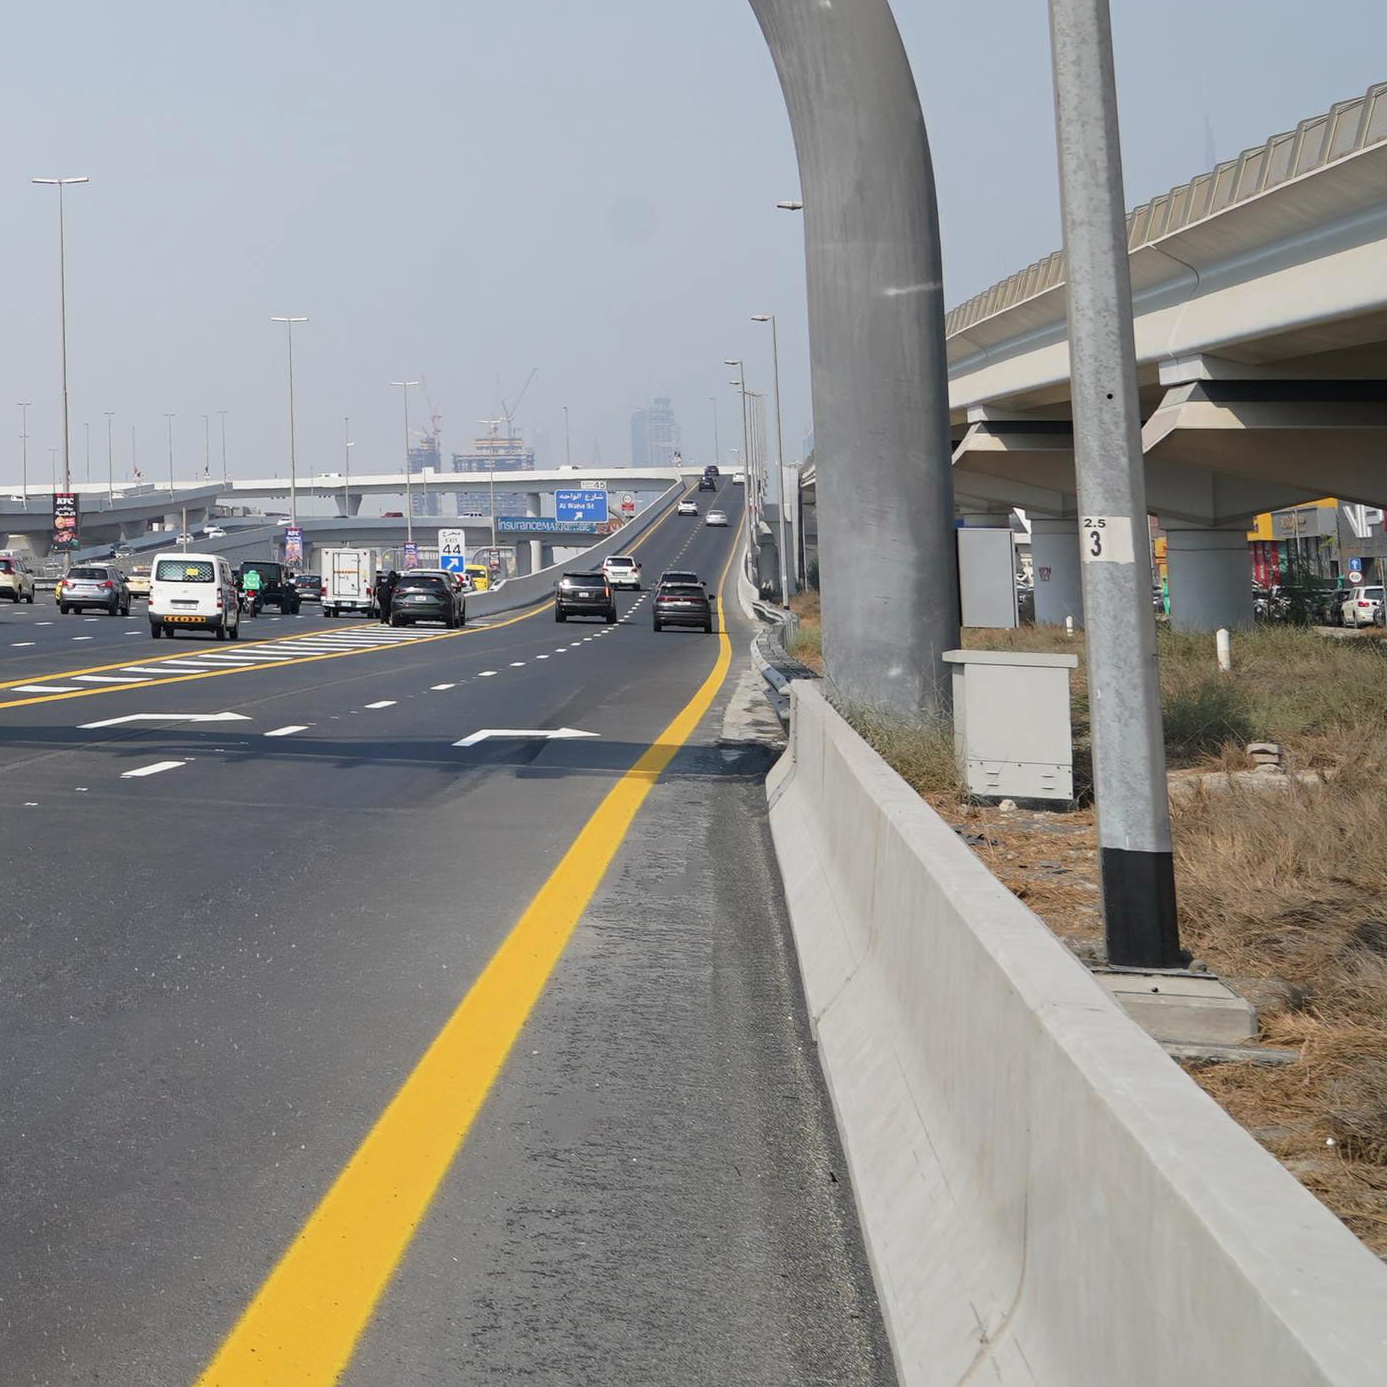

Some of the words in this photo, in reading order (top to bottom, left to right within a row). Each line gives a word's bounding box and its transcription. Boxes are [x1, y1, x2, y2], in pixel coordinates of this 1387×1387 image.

[1083, 518, 1106, 528] 2.5
[1090, 530, 1102, 557] 3
[442, 544, 461, 554] 44
